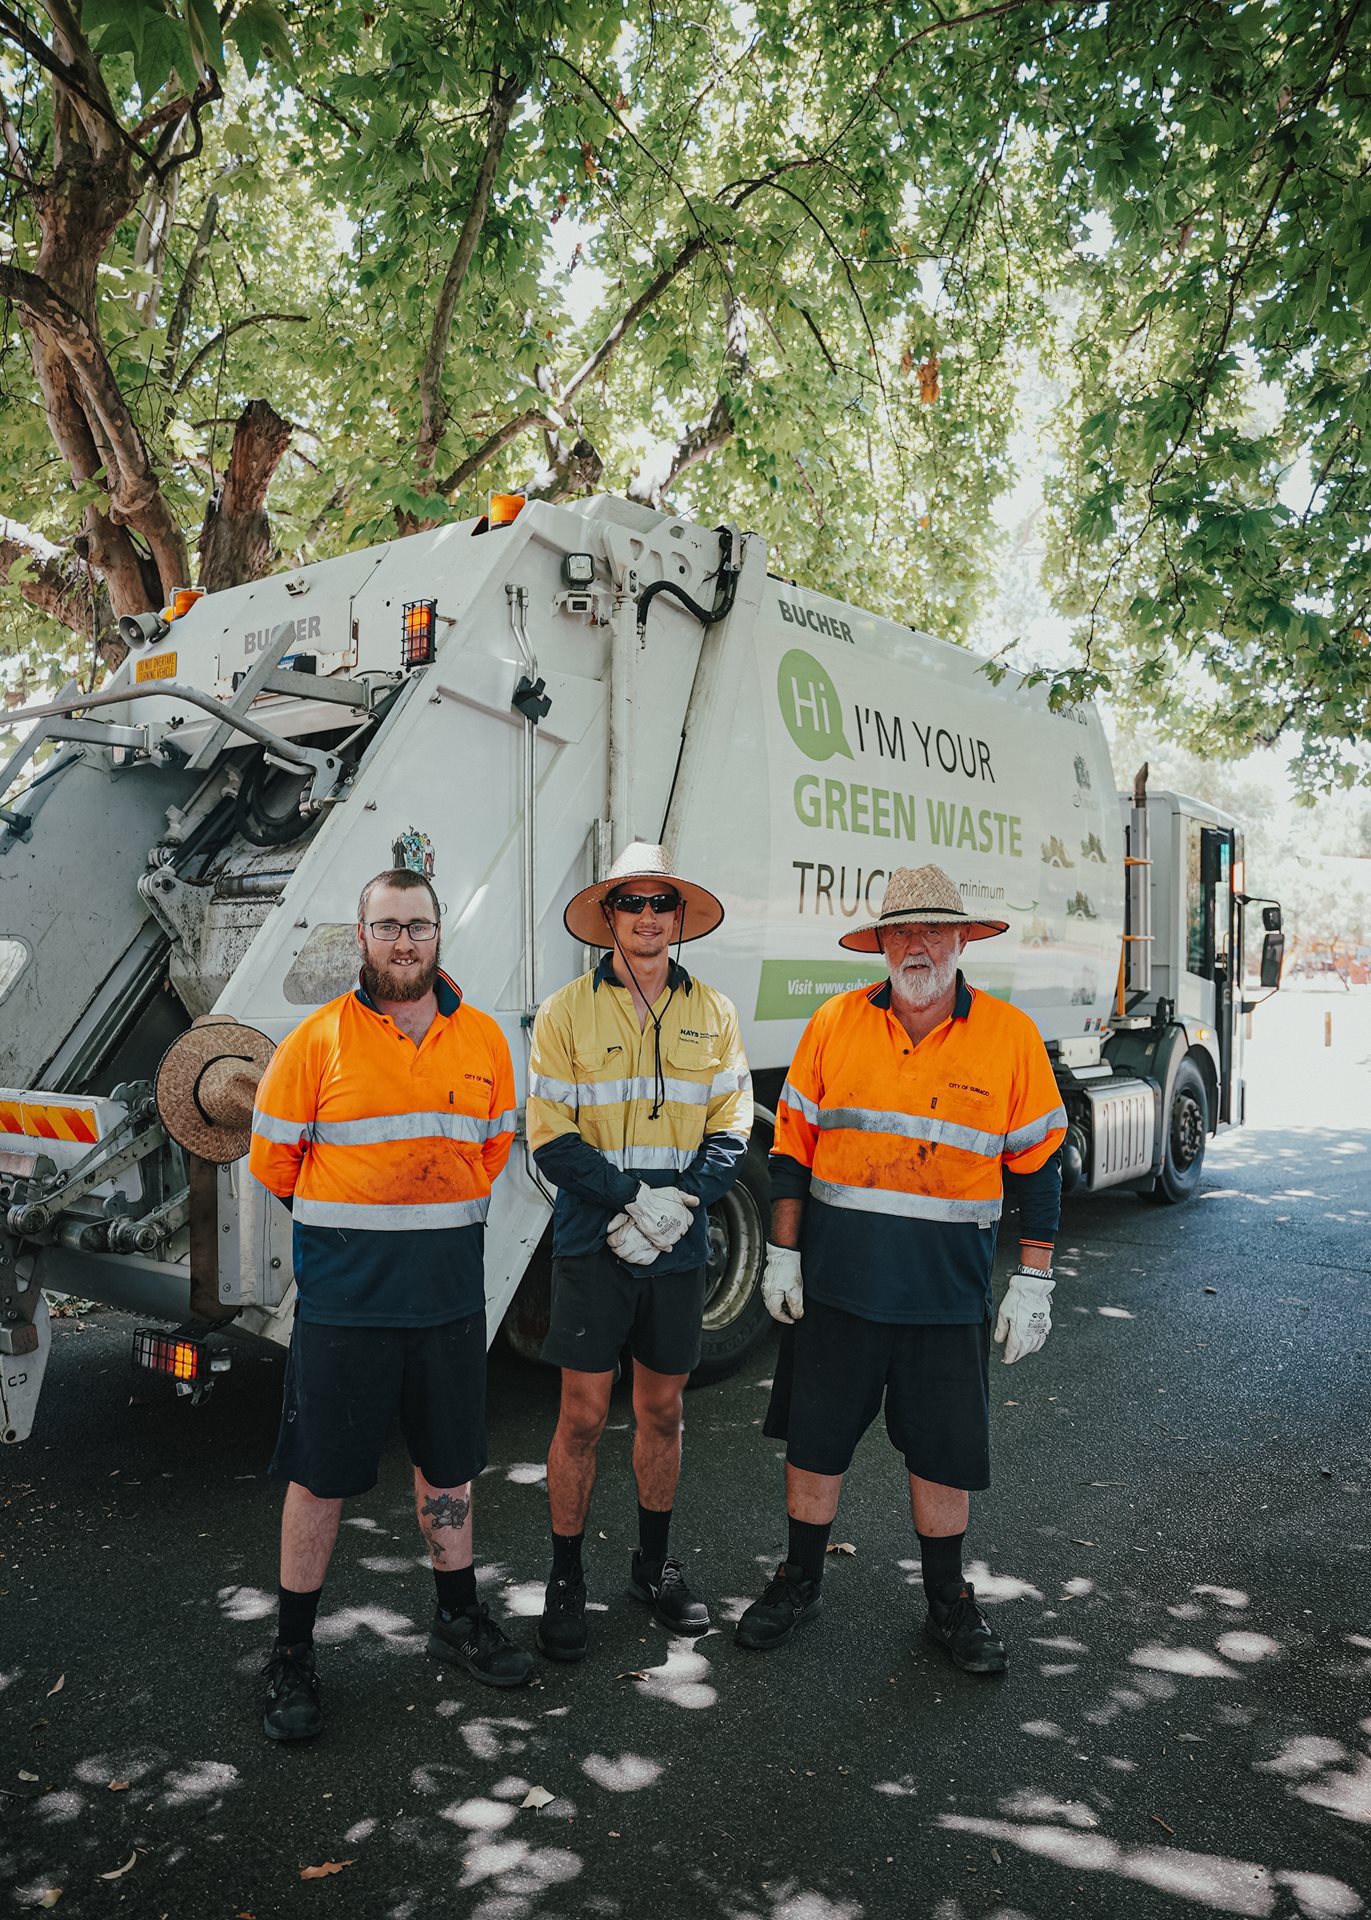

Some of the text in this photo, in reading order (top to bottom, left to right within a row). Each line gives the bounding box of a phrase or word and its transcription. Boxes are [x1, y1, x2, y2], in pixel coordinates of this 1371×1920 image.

[778, 599, 855, 645] BUCHER
[791, 676, 831, 735] Hi
[855, 704, 996, 783] I'M YOUR
[793, 773, 1023, 858] GREEN WASTE
[792, 860, 892, 919] TRUC
[960, 879, 1005, 900] minimum
[787, 979, 813, 995] Visit
[680, 1029, 699, 1038] HAYS
